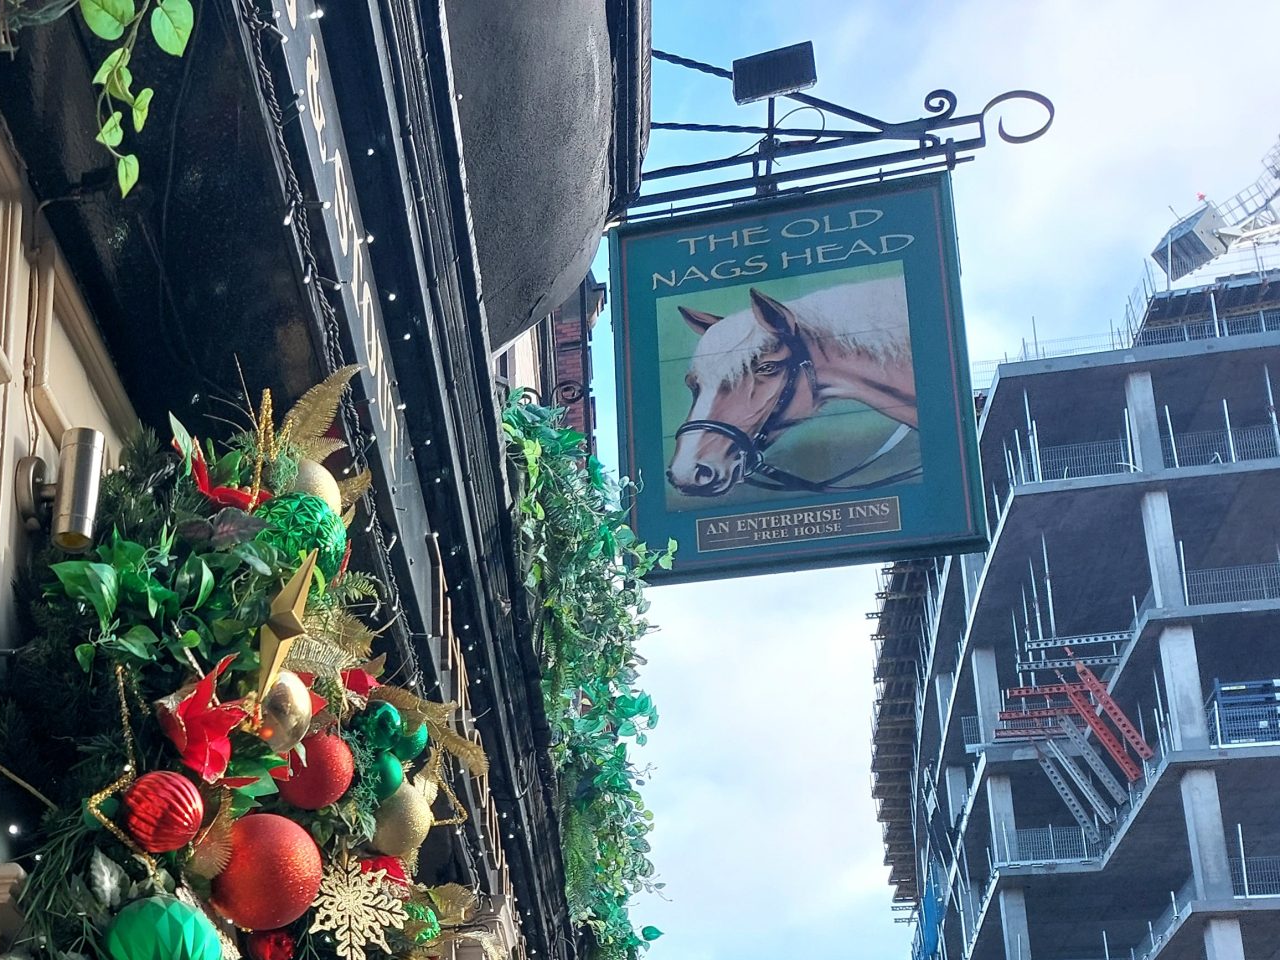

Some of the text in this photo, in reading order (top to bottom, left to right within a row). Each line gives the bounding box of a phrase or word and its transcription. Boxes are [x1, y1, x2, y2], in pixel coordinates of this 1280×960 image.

[677, 208, 884, 256] THE OLD
[651, 233, 916, 290] NAGS HEAD
[706, 501, 891, 536] AN ENTERPRISE INNS
[753, 522, 843, 542] FREE HOUSE
